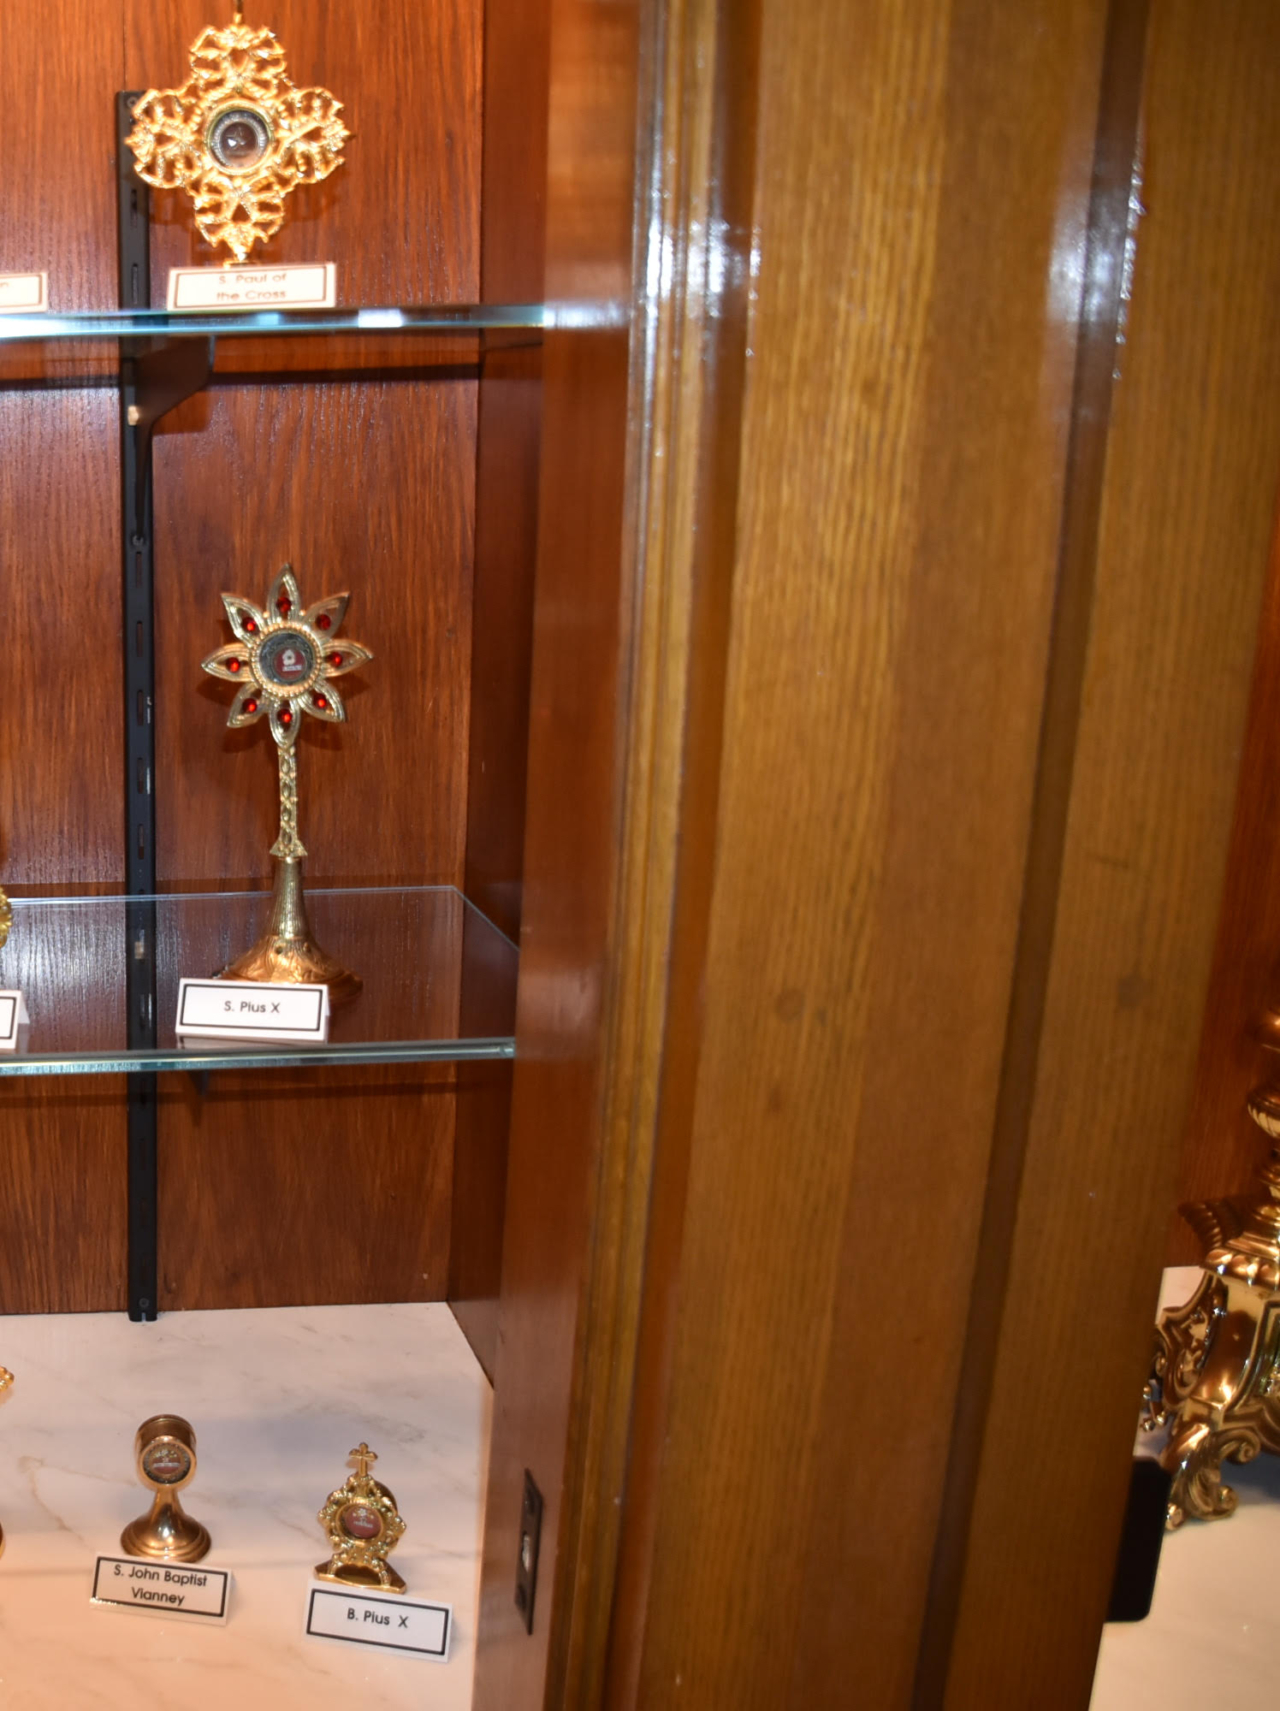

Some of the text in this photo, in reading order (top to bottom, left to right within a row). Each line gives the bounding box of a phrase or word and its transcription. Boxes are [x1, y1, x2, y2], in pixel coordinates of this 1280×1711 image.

[235, 274, 268, 284] Paul
[272, 273, 288, 282] of
[216, 290, 287, 301] the Cross
[223, 1000, 281, 1014] S. Pius X
[113, 1563, 208, 1588] S. John Baptist
[131, 1586, 186, 1608] Vianney
[346, 1606, 410, 1629] B. Pius X
